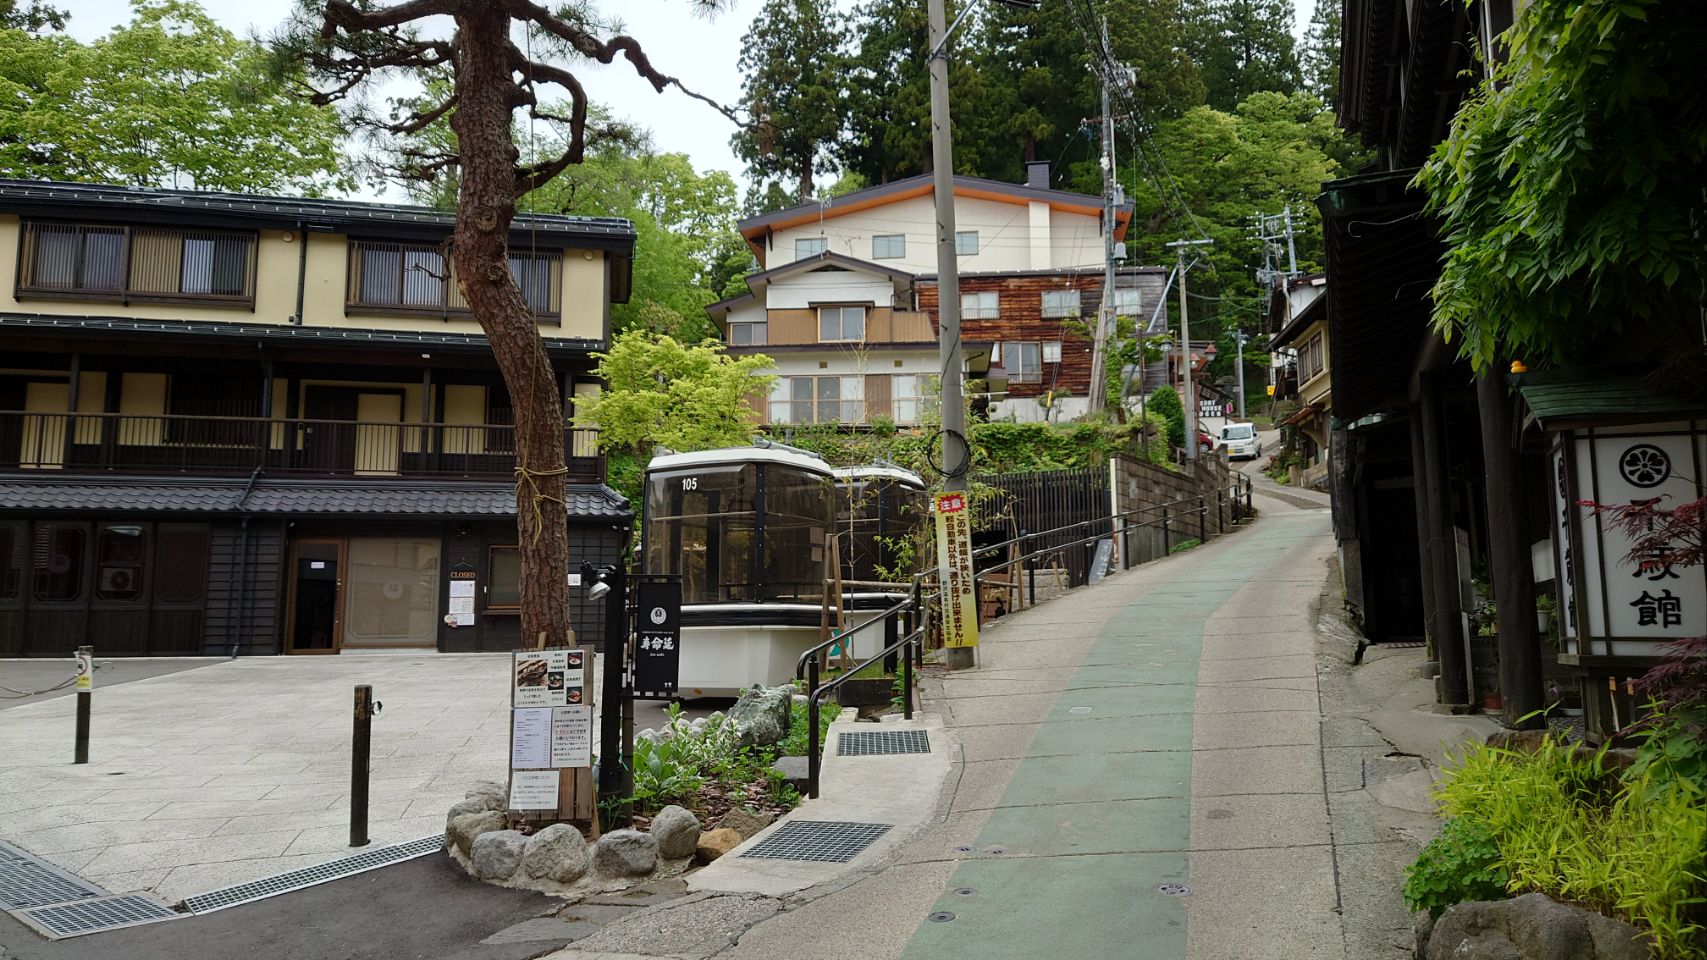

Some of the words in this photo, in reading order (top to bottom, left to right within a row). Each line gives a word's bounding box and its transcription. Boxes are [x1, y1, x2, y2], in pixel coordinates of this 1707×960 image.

[681, 477, 698, 491] 105
[940, 498, 962, 511] 注意
[450, 571, 476, 579] CLOSED
